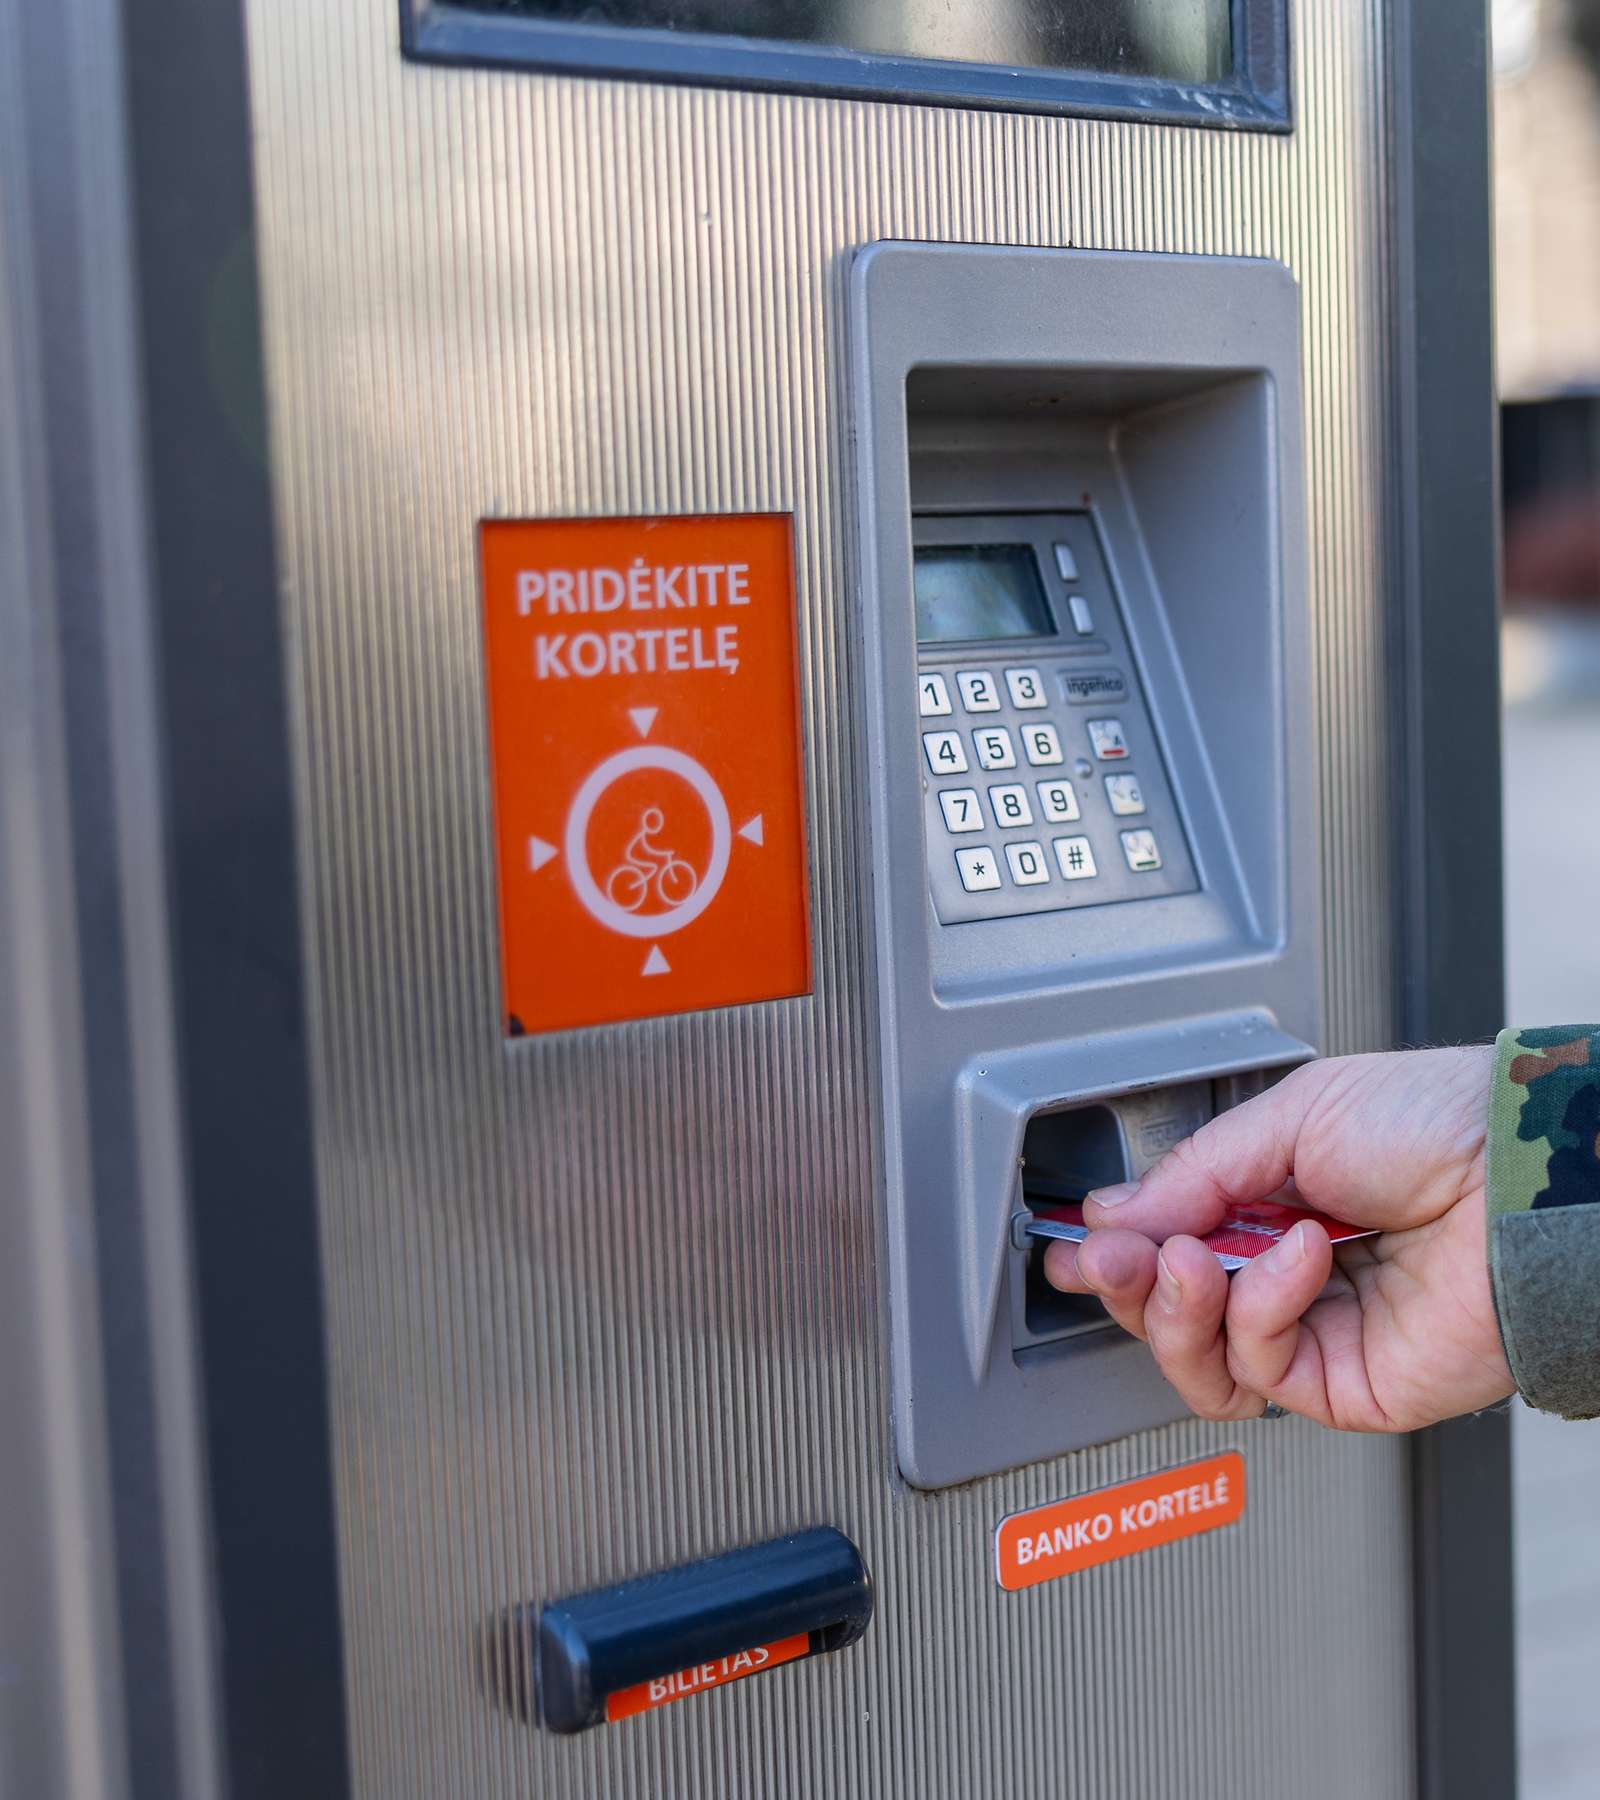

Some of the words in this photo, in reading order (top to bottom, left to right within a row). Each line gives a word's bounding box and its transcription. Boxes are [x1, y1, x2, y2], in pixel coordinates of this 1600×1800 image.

[516, 558, 751, 616] PRIDĖKITE
[534, 625, 740, 680] KORTELĘ
[924, 682, 940, 707] 1
[970, 679, 990, 703] 2
[1018, 676, 1036, 699] 3
[1066, 679, 1123, 697] ingenico
[938, 740, 956, 764] 4
[986, 736, 1004, 760] 5
[1034, 732, 1052, 755] 6
[952, 799, 968, 822] 7
[1002, 793, 1021, 817] 8
[1050, 789, 1068, 812] 9
[1067, 845, 1084, 870] #
[1016, 1513, 1114, 1566] BANKO
[1119, 1471, 1230, 1535] KORTELĖ
